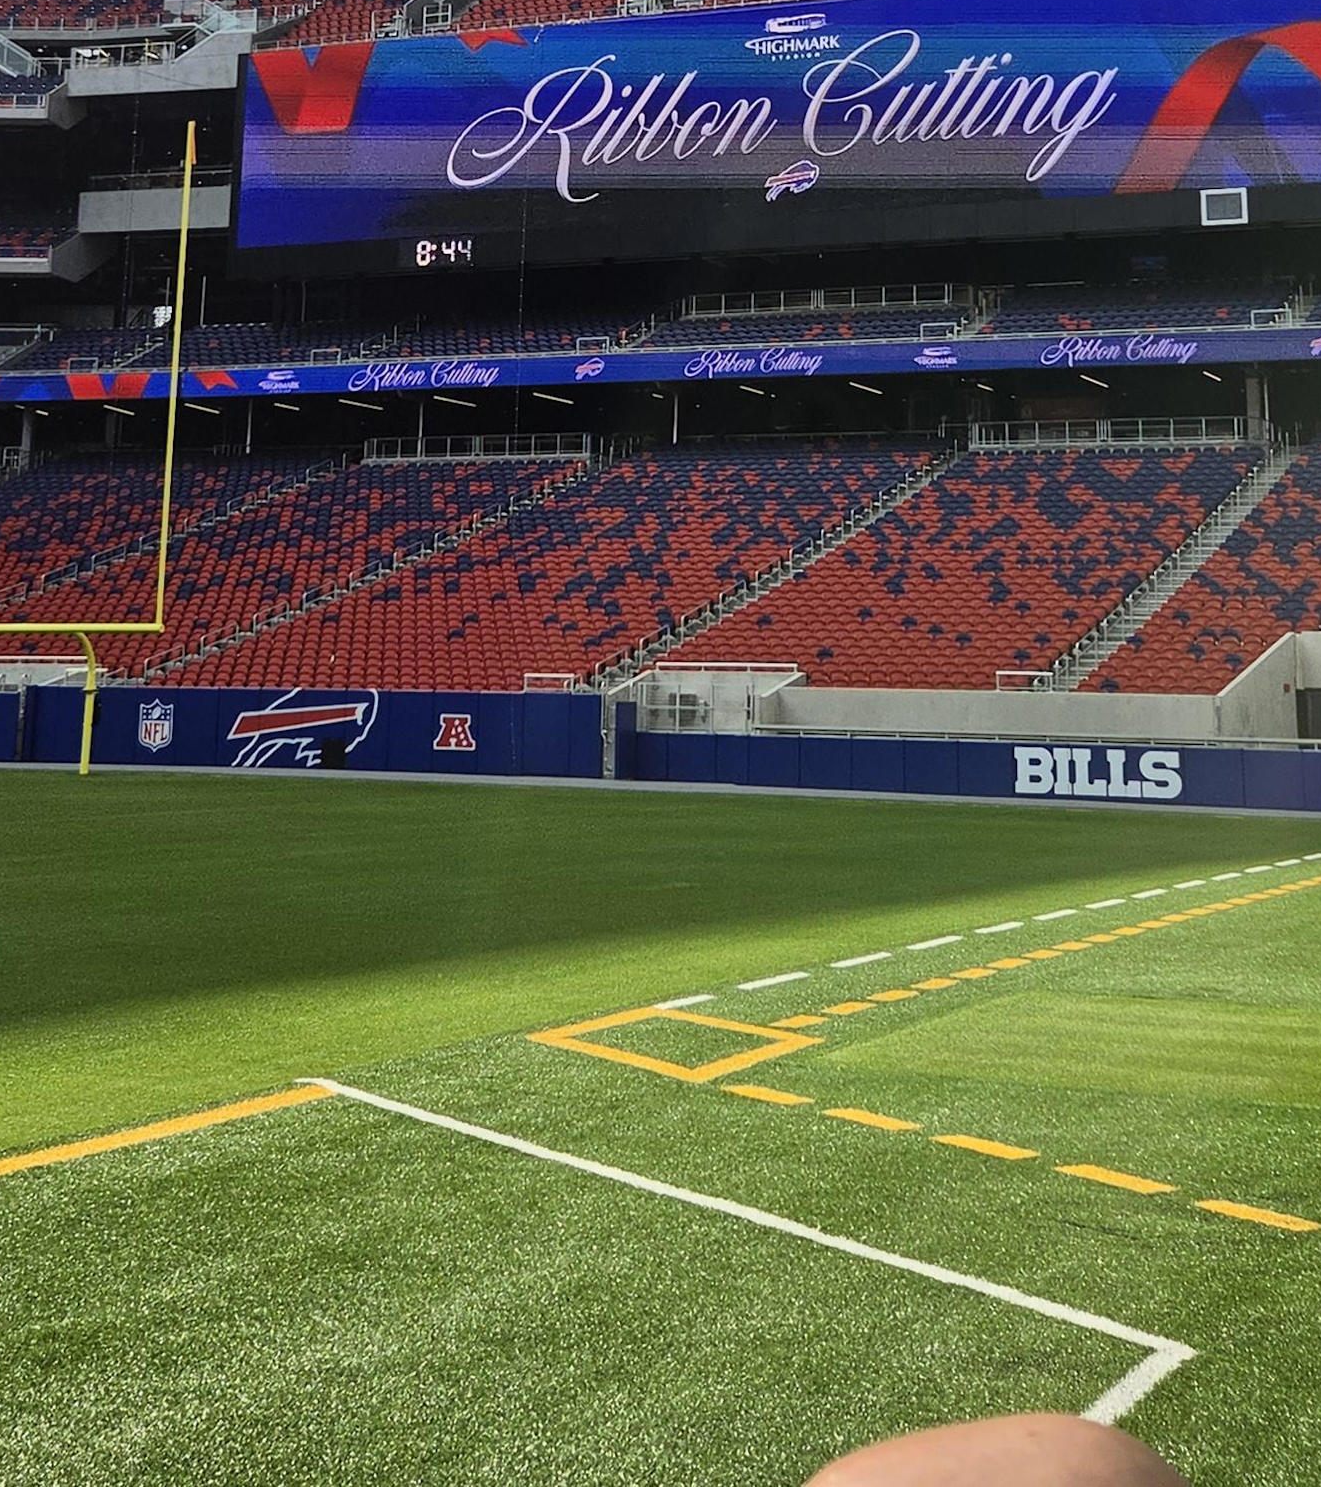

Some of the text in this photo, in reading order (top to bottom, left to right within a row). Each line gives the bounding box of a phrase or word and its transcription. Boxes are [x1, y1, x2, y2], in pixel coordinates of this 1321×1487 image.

[753, 34, 841, 56] HIGHMARK
[447, 29, 1119, 204] Ribbon Cutting
[414, 238, 473, 268] 8:44
[683, 347, 823, 379] Ribbon Cutting
[1040, 334, 1198, 368] Ribbon Cutting
[347, 360, 500, 392] Ribbon Cutting
[142, 722, 169, 744] NFL
[1014, 745, 1182, 800] BILLS
